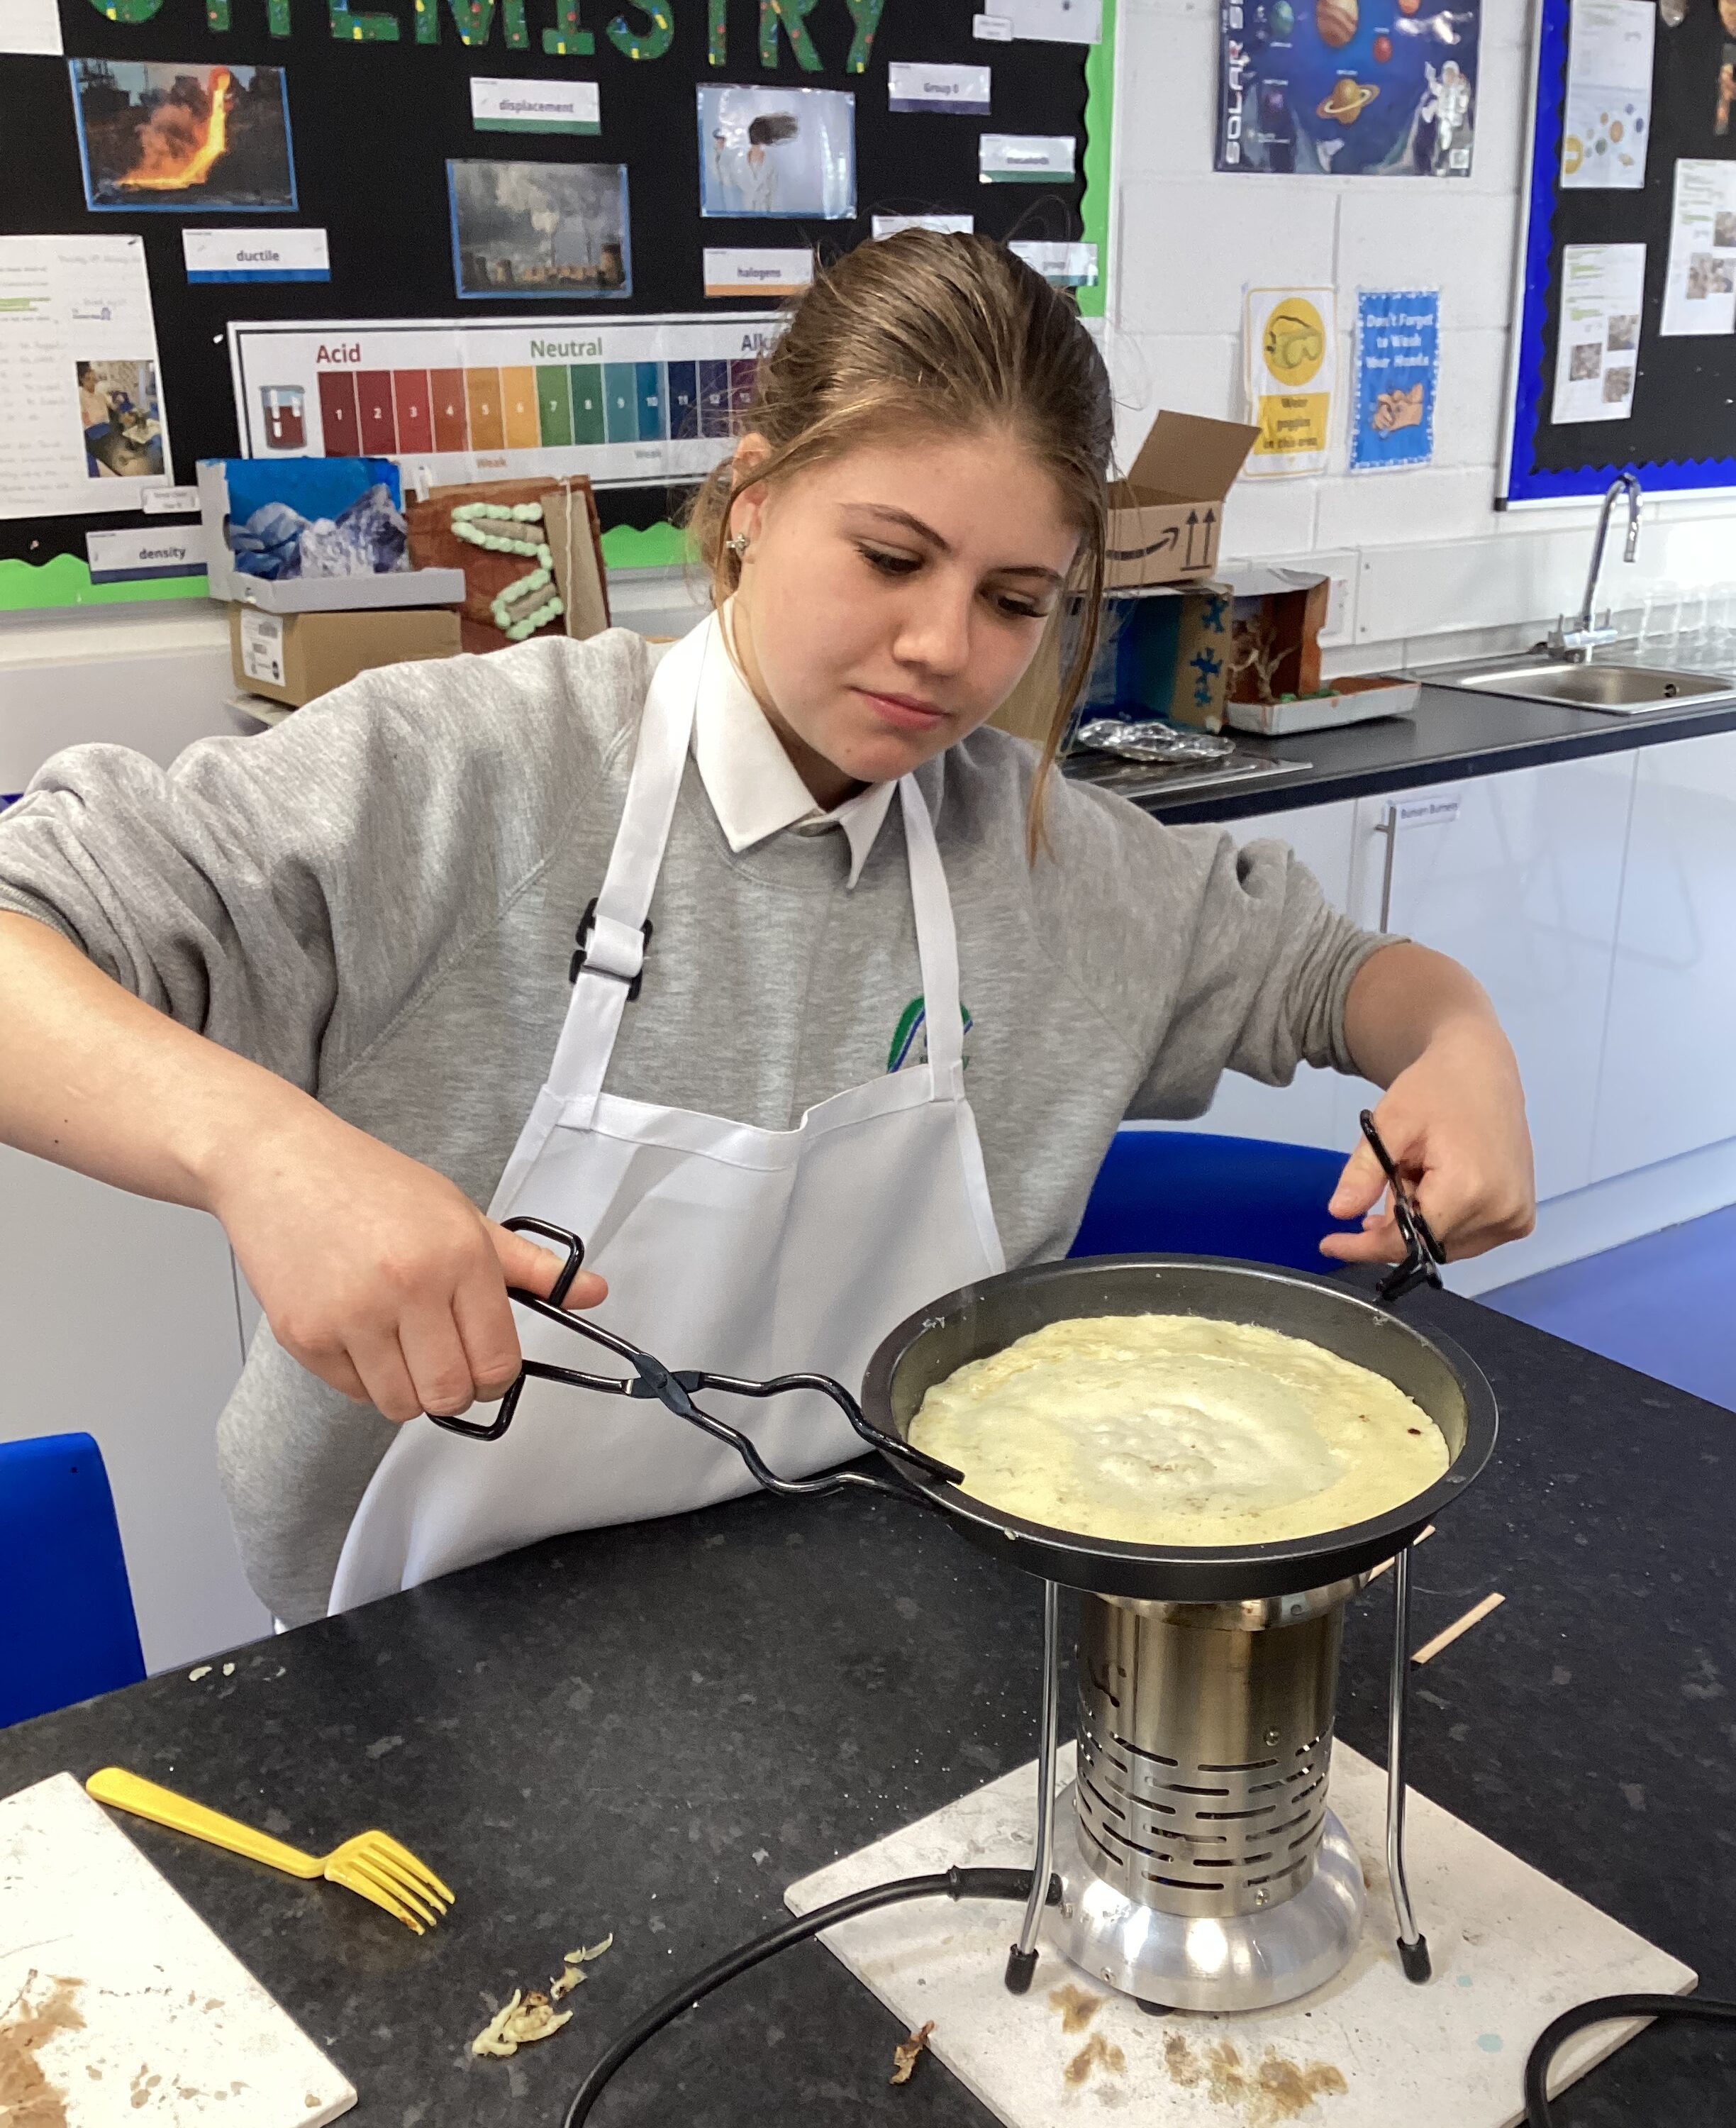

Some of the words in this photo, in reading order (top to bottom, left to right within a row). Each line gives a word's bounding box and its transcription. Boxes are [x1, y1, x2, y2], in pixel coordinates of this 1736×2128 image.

[1228, 0, 1244, 29] S
[91, 0, 884, 73] ISTRY
[923, 82, 951, 96] Group
[499, 99, 574, 113] displacement
[1226, 40, 1244, 164] SOLAR
[236, 250, 280, 262] ductile
[738, 267, 781, 280] halogens
[1367, 312, 1396, 327] Don't
[1399, 314, 1432, 330] Forget
[530, 338, 603, 358] Neutral
[1391, 333, 1422, 348] Wash
[316, 343, 361, 364] Acid
[1394, 353, 1430, 367] Hands
[335, 409, 343, 420] 1
[374, 407, 382, 419] 2
[409, 406, 417, 417] 3
[445, 405, 454, 416] 4
[482, 404, 489, 415] 5
[516, 402, 524, 413] 6
[550, 400, 557, 411] 7
[585, 399, 592, 409] 8
[617, 397, 625, 409] 9
[1281, 398, 1308, 408] Wear
[139, 547, 186, 560] density
